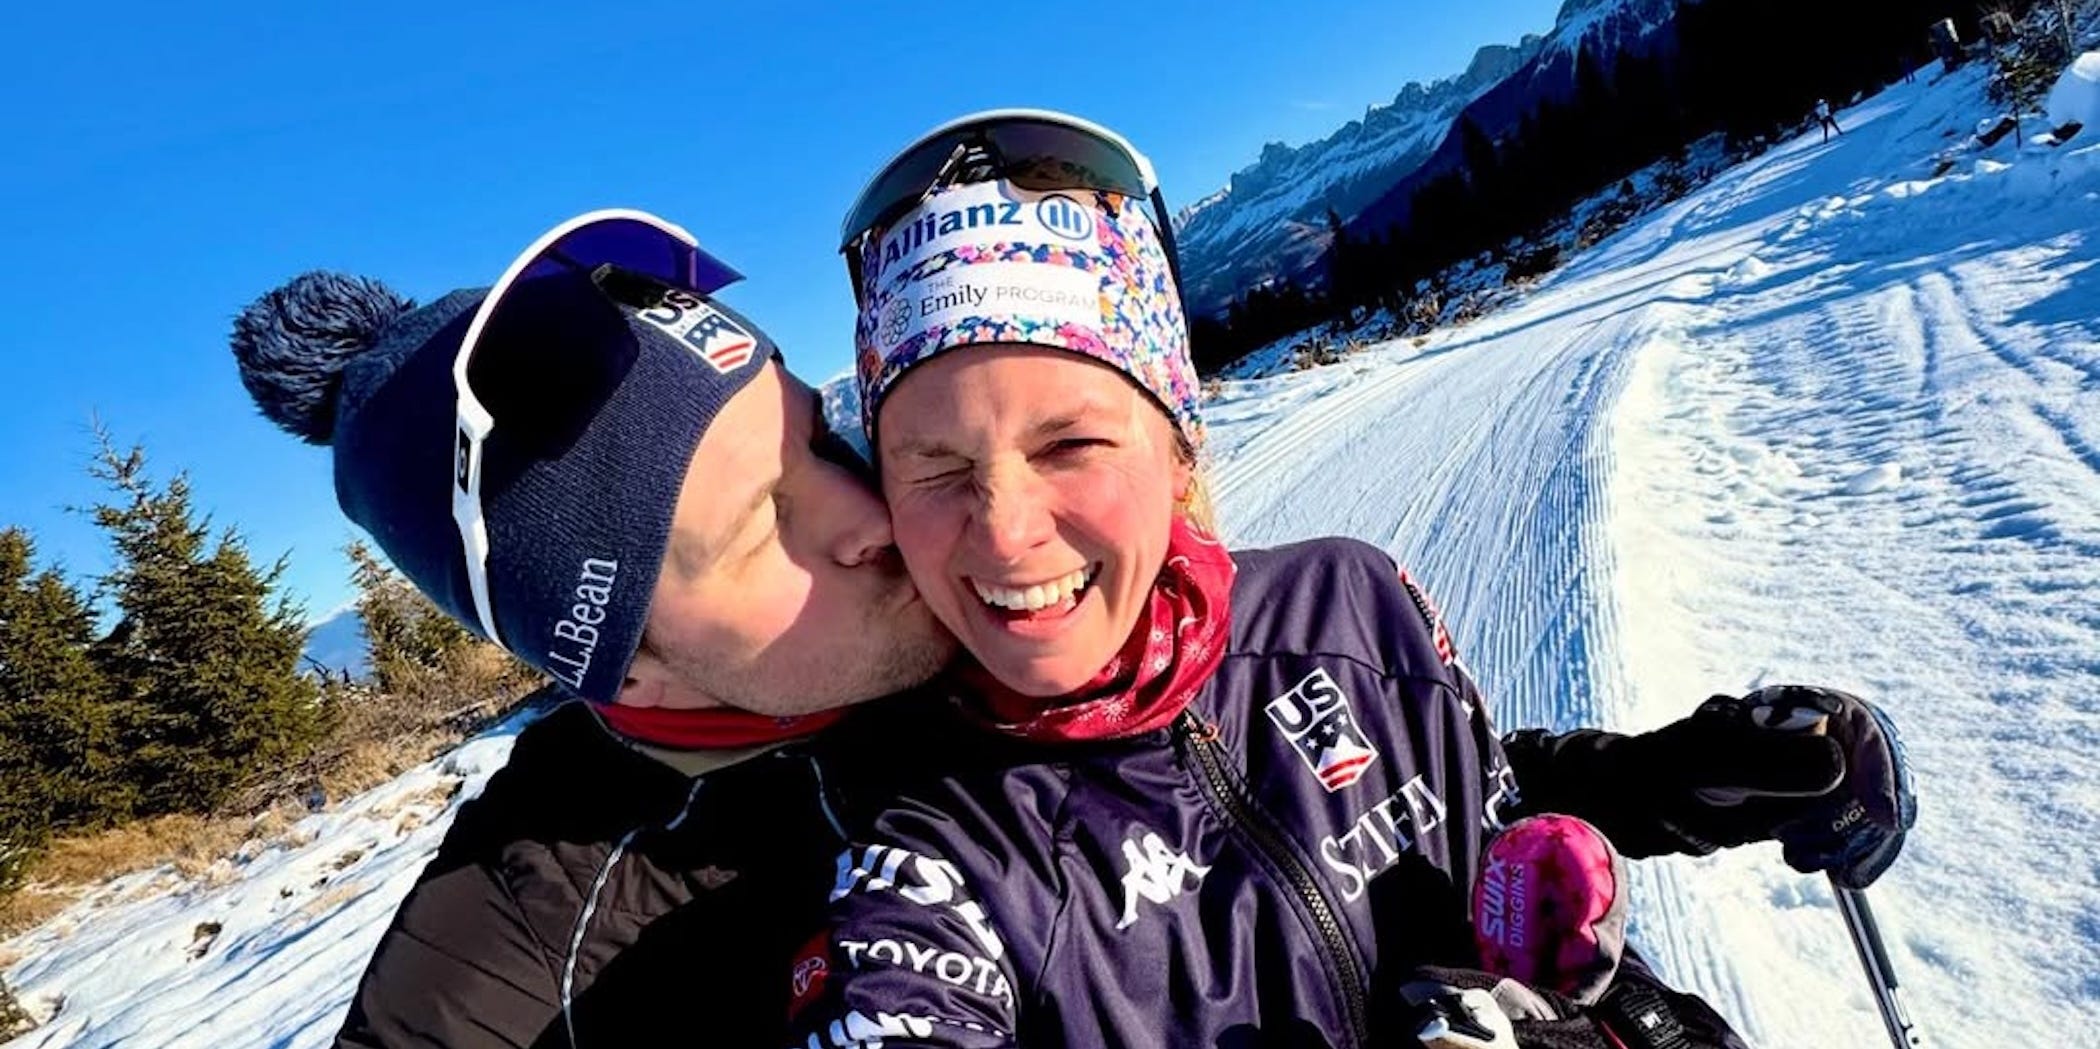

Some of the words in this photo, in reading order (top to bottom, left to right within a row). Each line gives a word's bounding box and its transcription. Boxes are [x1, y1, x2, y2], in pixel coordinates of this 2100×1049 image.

[882, 202, 1023, 270] Allianz
[644, 290, 700, 326] US
[920, 284, 988, 318] Emily
[996, 286, 1098, 310] PROGRAM
[928, 277, 954, 294] THE
[1268, 673, 1342, 734] US
[1320, 773, 1448, 903] STIFEL
[1482, 851, 1506, 945] SWIX
[1509, 862, 1526, 948] DIGGINS
[839, 938, 1014, 1009] TOYOTA
